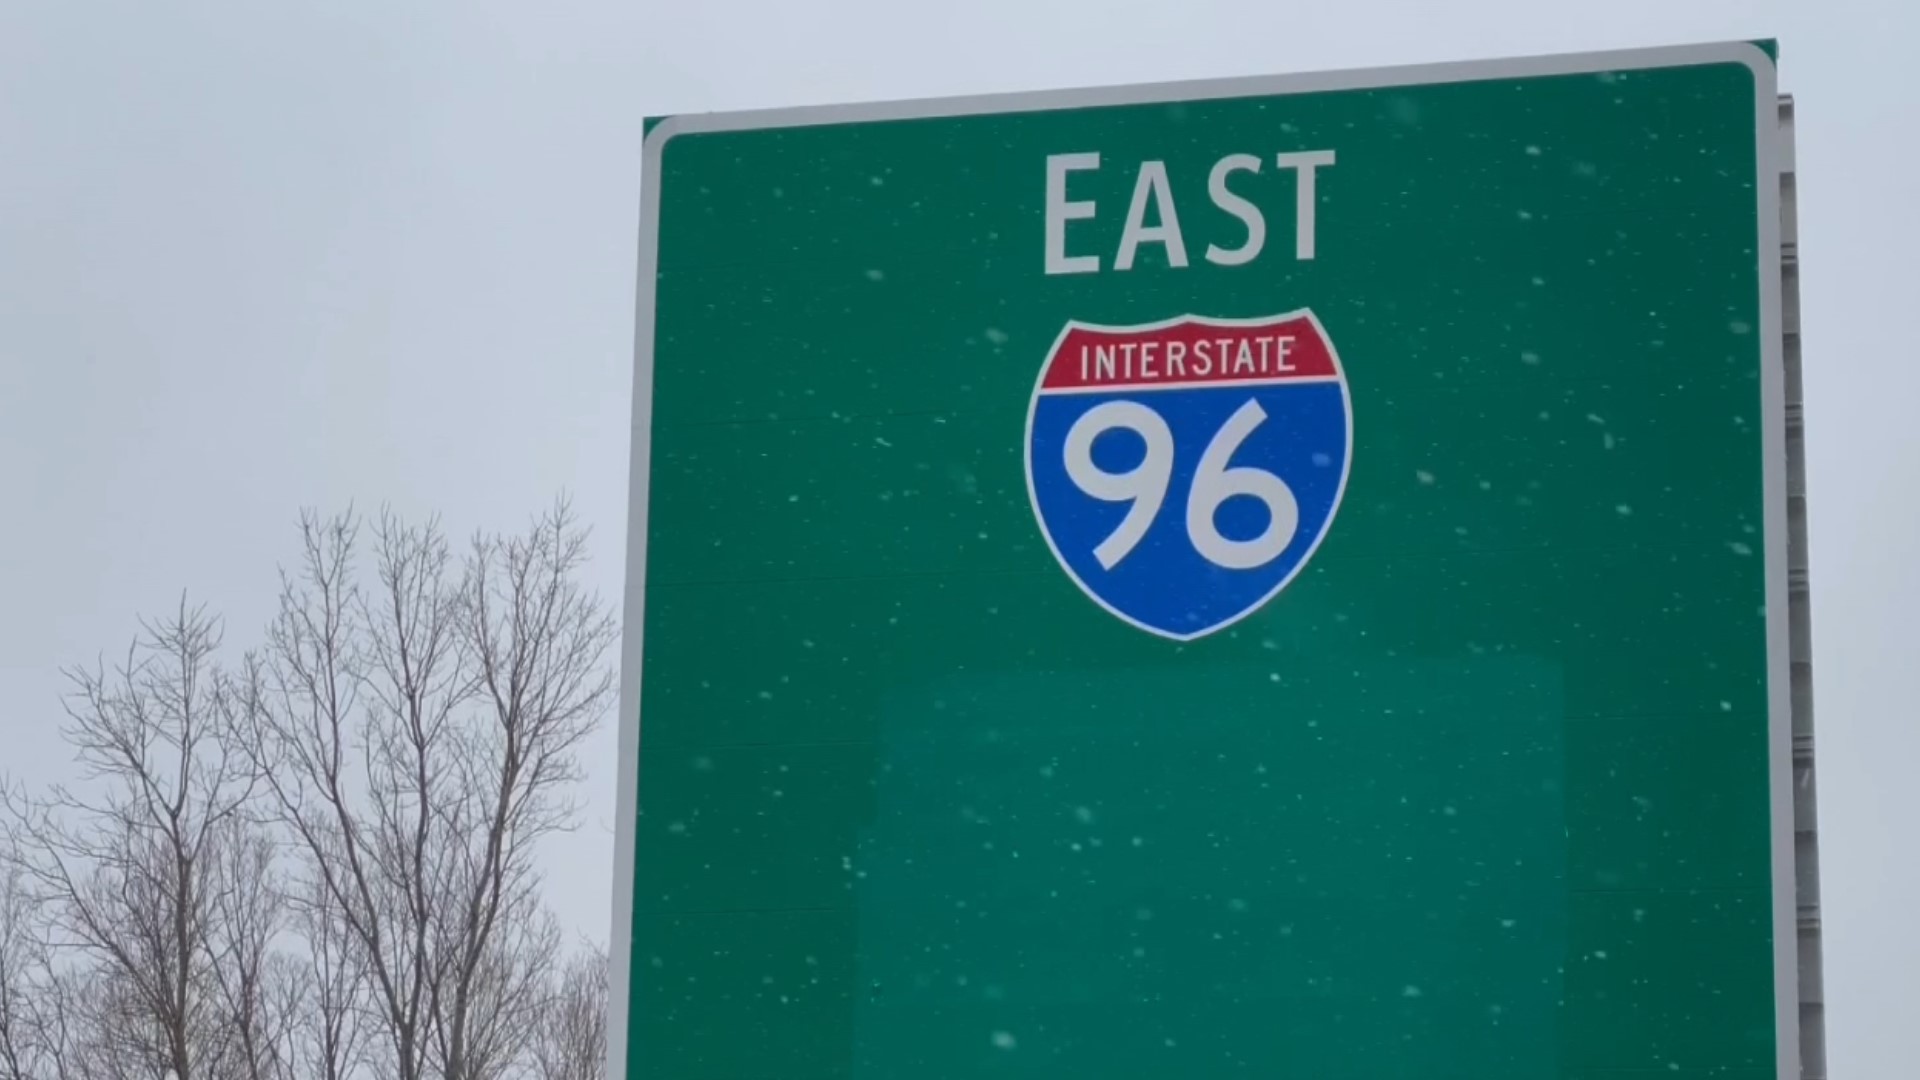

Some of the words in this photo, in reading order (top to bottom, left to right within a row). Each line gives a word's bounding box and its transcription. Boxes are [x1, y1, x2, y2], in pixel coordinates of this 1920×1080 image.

[1044, 149, 1336, 275] EAST
[1080, 336, 1297, 381] INTERSTATE
[1063, 397, 1299, 571] 96
